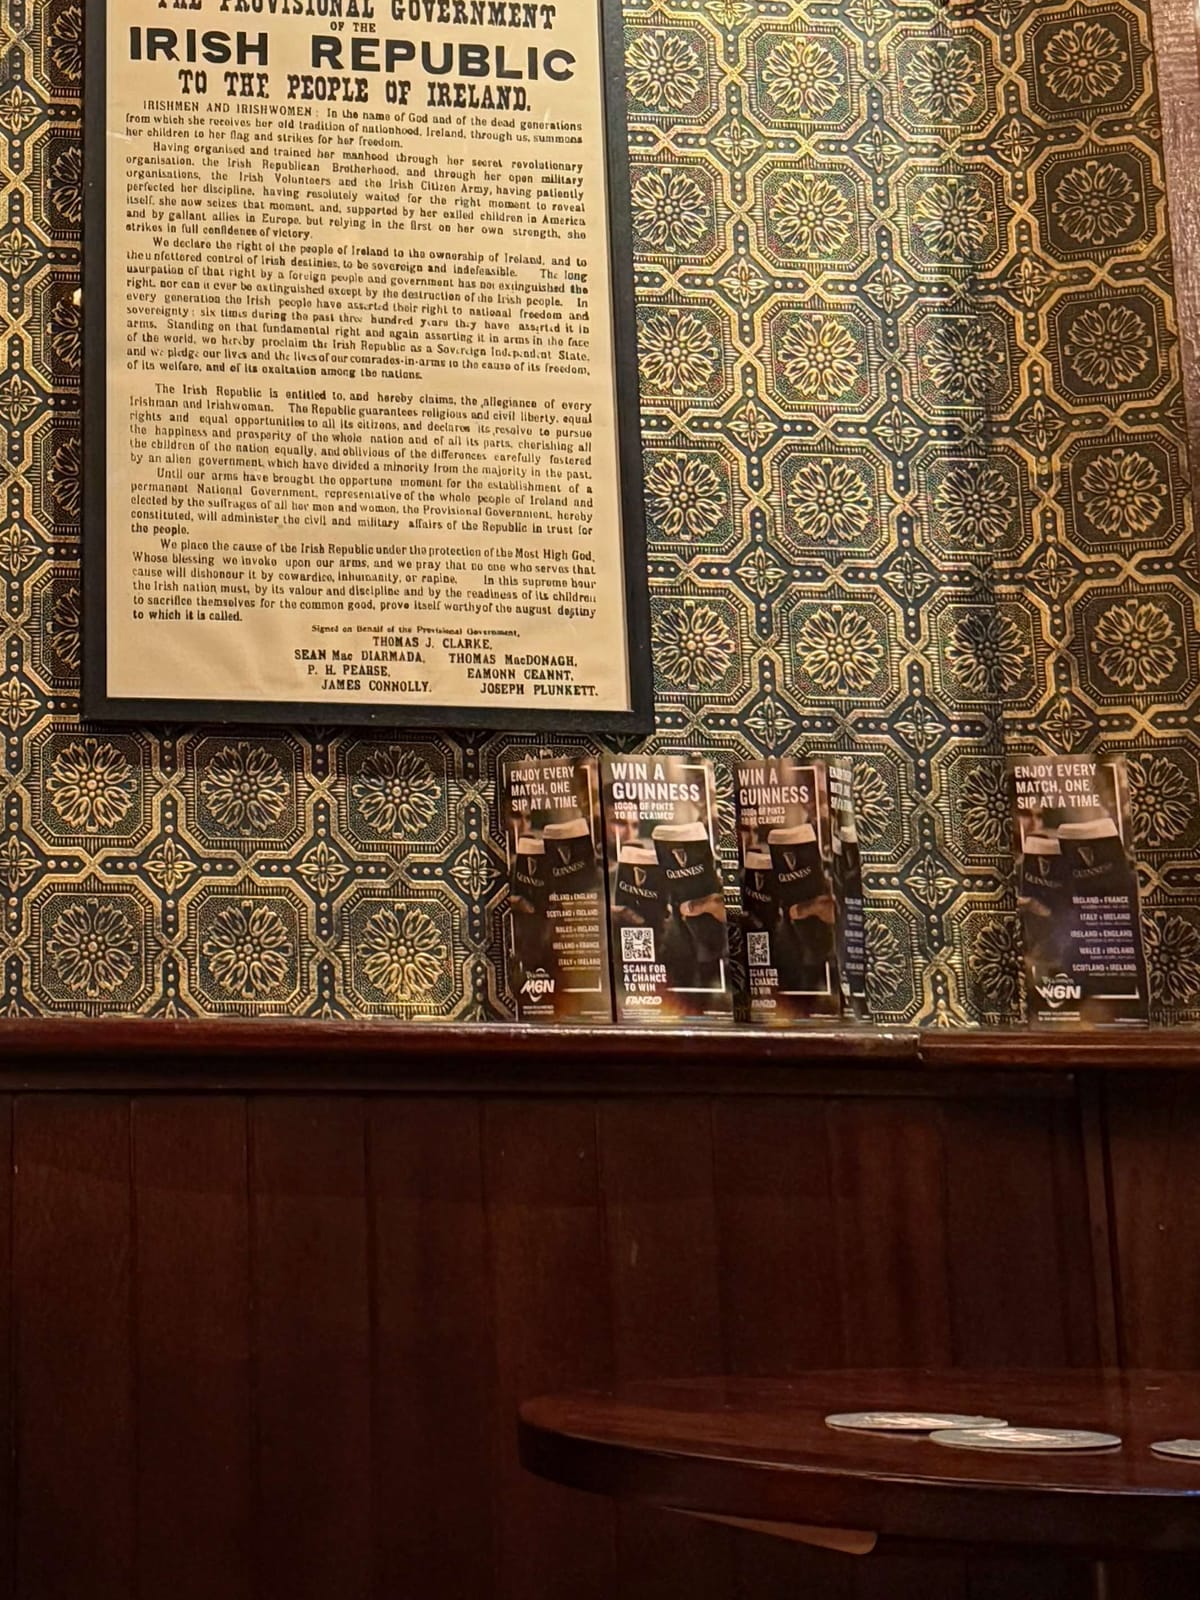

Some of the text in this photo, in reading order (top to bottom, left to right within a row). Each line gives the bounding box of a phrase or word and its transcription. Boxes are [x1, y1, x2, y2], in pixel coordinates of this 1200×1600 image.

[329, 20, 375, 32] OF THE
[129, 26, 576, 81] IRISH REPUBLIC
[178, 68, 530, 111] TO THE PEOPLE OF IRELAND.
[143, 99, 198, 112] IRISHMEN
[205, 102, 229, 113] AND
[326, 107, 337, 118] In
[341, 108, 358, 119] the
[362, 111, 390, 121] name
[393, 111, 405, 122] of
[408, 112, 428, 123] God
[432, 113, 452, 124] and
[455, 114, 466, 125] of
[470, 115, 487, 126] the
[490, 116, 515, 128] dead
[519, 119, 582, 131] generations
[125, 112, 150, 123] from
[153, 113, 184, 125] which
[187, 114, 205, 125] she
[208, 116, 251, 127] receives
[255, 117, 273, 128] her
[277, 119, 294, 129] old
[298, 120, 345, 131] tradition
[348, 122, 359, 132] of
[470, 129, 512, 142] through
[532, 134, 582, 143] summons
[125, 125, 143, 136] her
[146, 126, 189, 138] children
[194, 129, 204, 138] to
[208, 128, 226, 139] her
[230, 129, 249, 142] flag
[253, 131, 273, 141] and
[276, 132, 313, 143] strikes
[317, 133, 333, 144] for
[336, 134, 354, 145] her
[372, 635, 419, 647] THOMAS
[424, 636, 434, 648] J.
[294, 648, 326, 660] SEAN
[331, 649, 352, 661] Mac
[447, 652, 496, 664] THOMAS
[307, 663, 317, 675] P.
[324, 663, 336, 675] H.
[467, 667, 515, 679] EAMONN
[321, 678, 361, 690] JAMES
[479, 682, 524, 695] JOSEPH
[511, 766, 575, 782] ENJOY EVERY
[611, 763, 665, 780] WIN A
[738, 768, 778, 786] WIN A
[1014, 763, 1096, 778] ENJOY EVERY
[550, 782, 570, 794] ONE
[612, 782, 700, 802] GUINNESS
[1065, 779, 1090, 792] ONE
[740, 785, 809, 806] GUINNESS
[1017, 794, 1100, 809] SIP AT A TIME
[512, 796, 578, 812] SIP AT A TIME
[640, 802, 650, 810] OF
[651, 802, 674, 810] PINTS
[615, 812, 625, 820] TO
[640, 811, 674, 820] CLAIMED
[666, 864, 704, 879] GUINNESS
[619, 880, 658, 899] GUINNESS
[623, 964, 666, 973] SCAN FOR
[623, 973, 667, 983] A CHANCE
[624, 983, 656, 992] TO WIN
